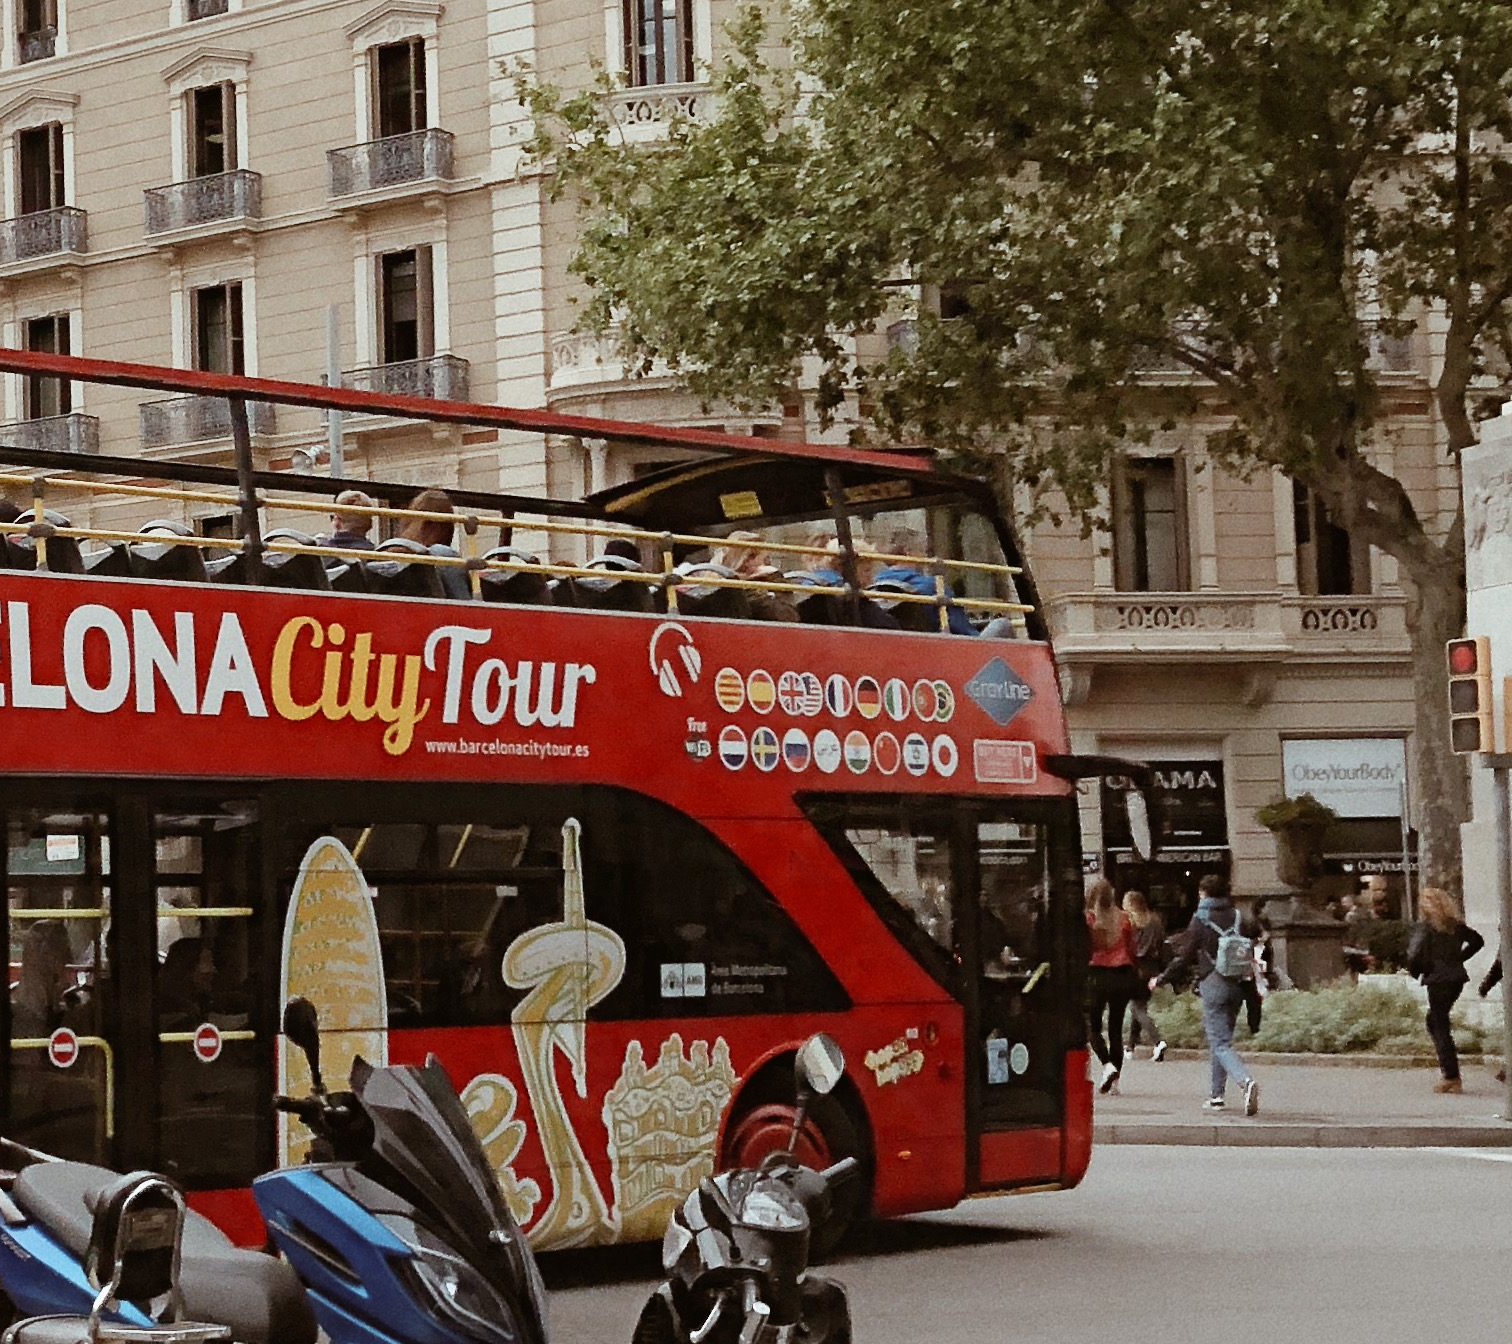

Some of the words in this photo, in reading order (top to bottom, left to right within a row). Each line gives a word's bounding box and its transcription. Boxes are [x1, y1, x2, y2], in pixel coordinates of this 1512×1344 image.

[270, 615, 431, 756] City
[424, 624, 596, 728] Tour
[425, 737, 590, 760] www.barcelonacitytour.es
